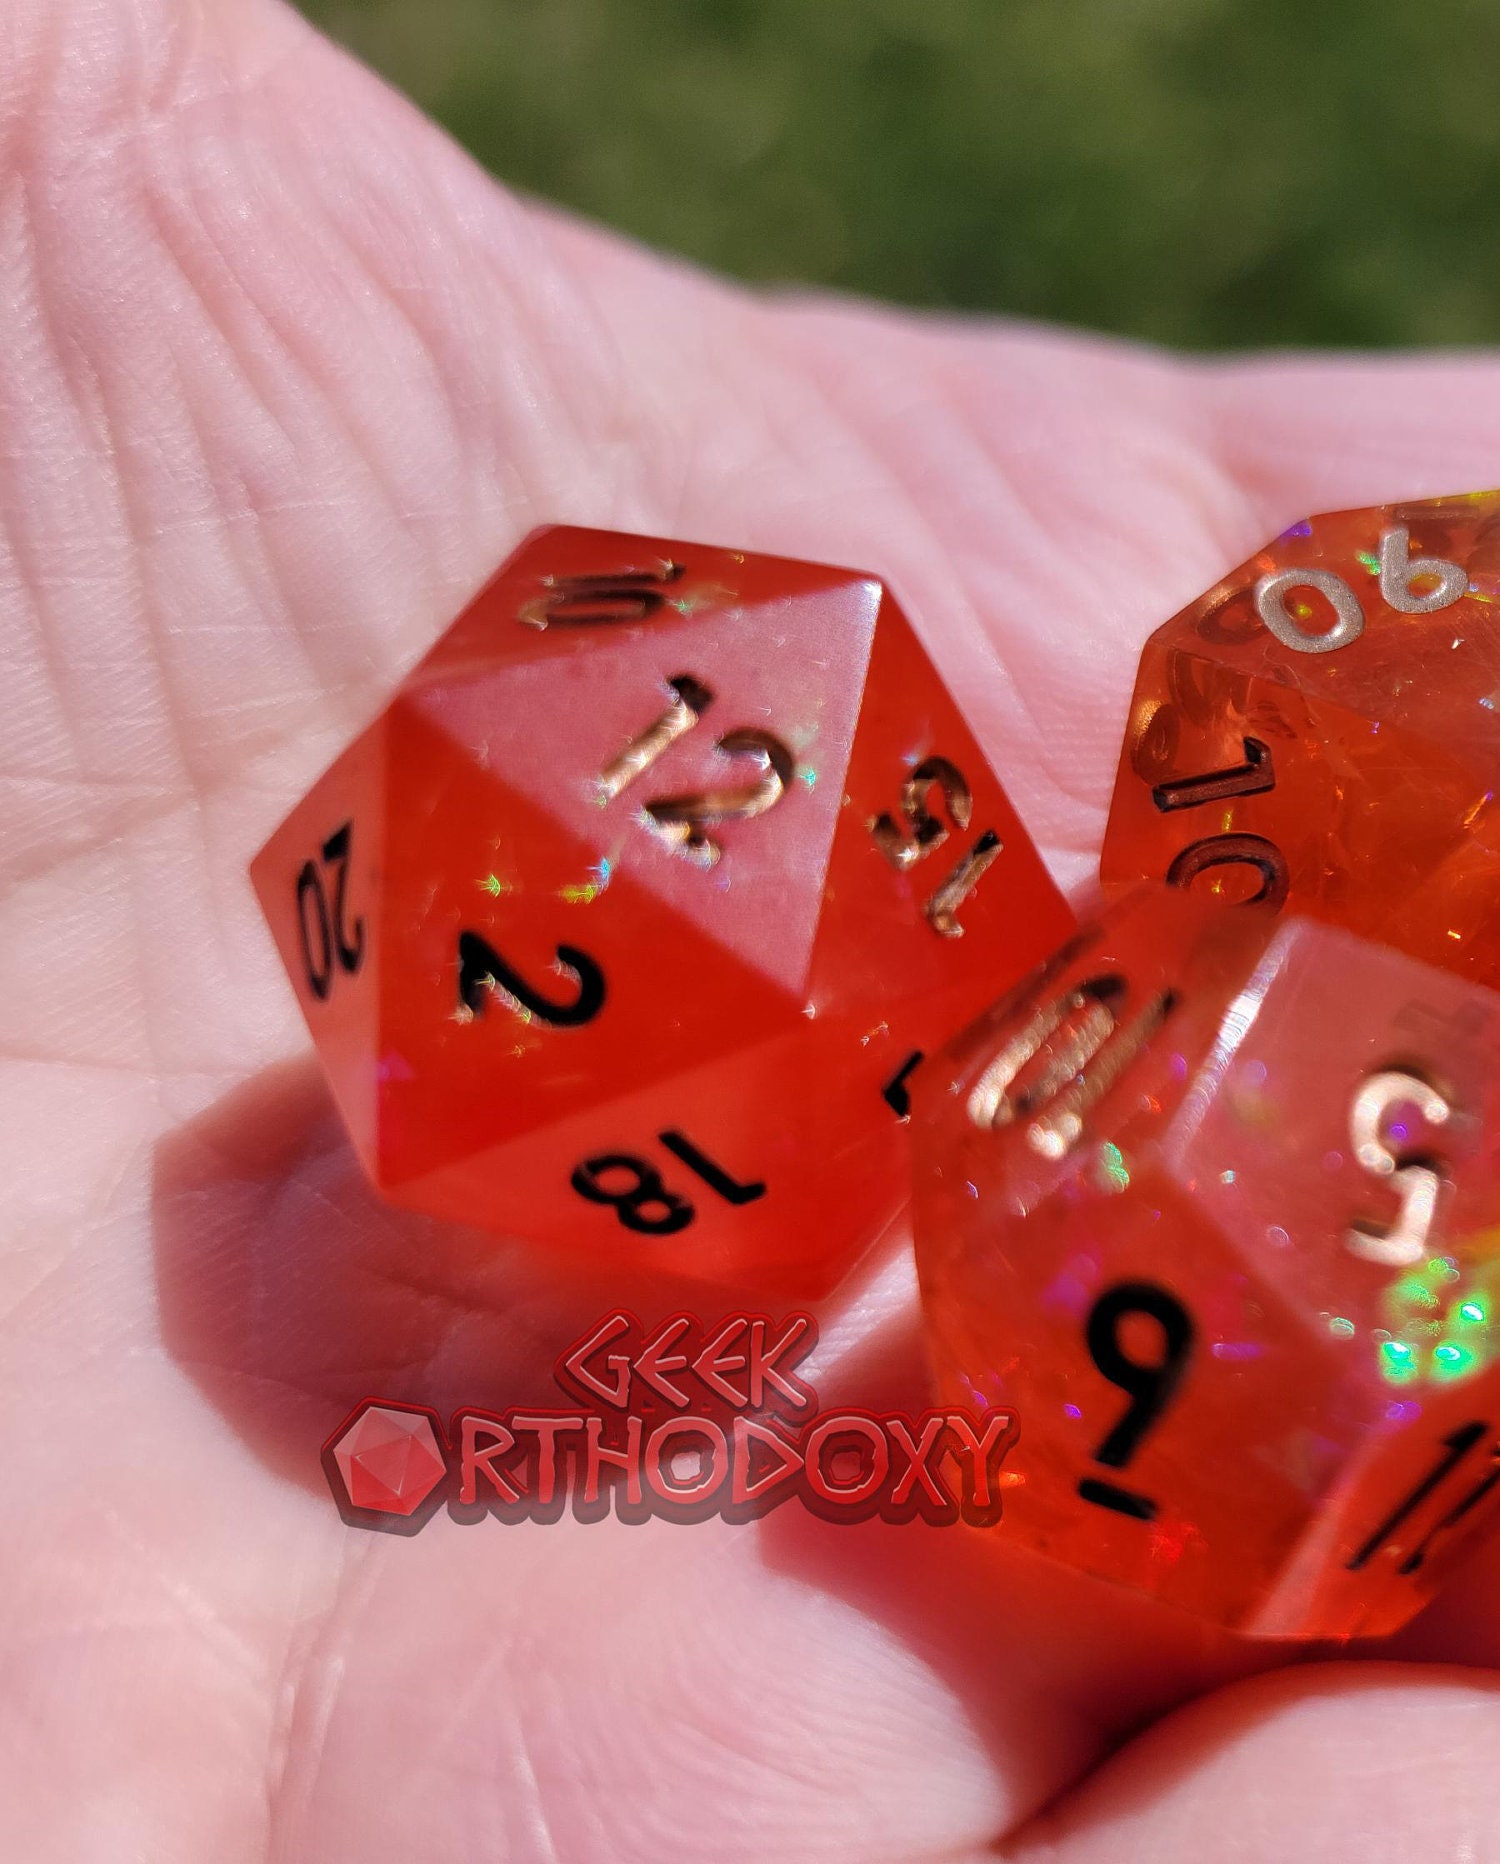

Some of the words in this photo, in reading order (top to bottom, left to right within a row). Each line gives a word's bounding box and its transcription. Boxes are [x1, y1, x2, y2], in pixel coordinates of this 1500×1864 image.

[596, 674, 797, 868] 12
[865, 756, 1004, 938] 15
[294, 820, 367, 1002] 20
[452, 928, 607, 1028] 2
[571, 1128, 767, 1236] 18
[1344, 1064, 1452, 1266] 5
